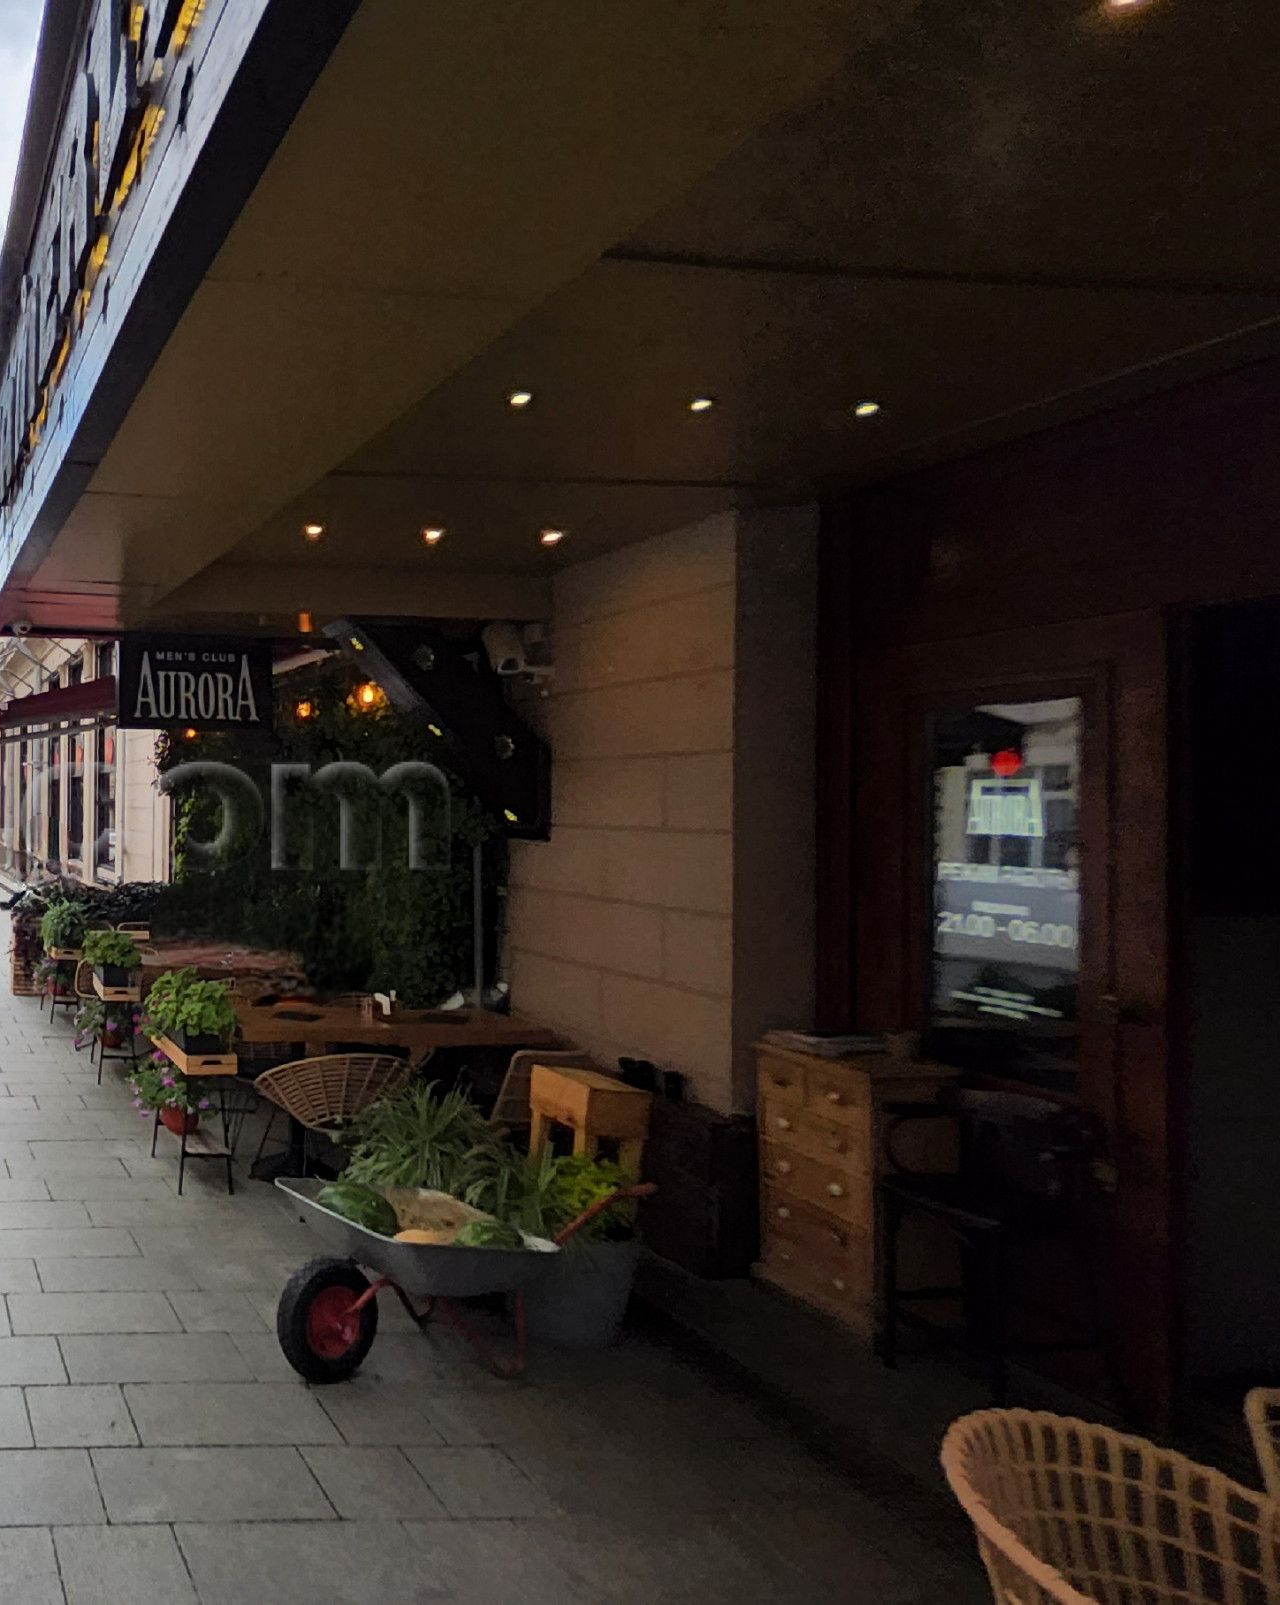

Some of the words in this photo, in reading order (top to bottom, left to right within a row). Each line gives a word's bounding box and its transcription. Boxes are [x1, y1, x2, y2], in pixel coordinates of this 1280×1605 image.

[154, 650, 197, 663] MEN'S
[201, 651, 237, 663] CLUB
[133, 650, 261, 723] AURORA
